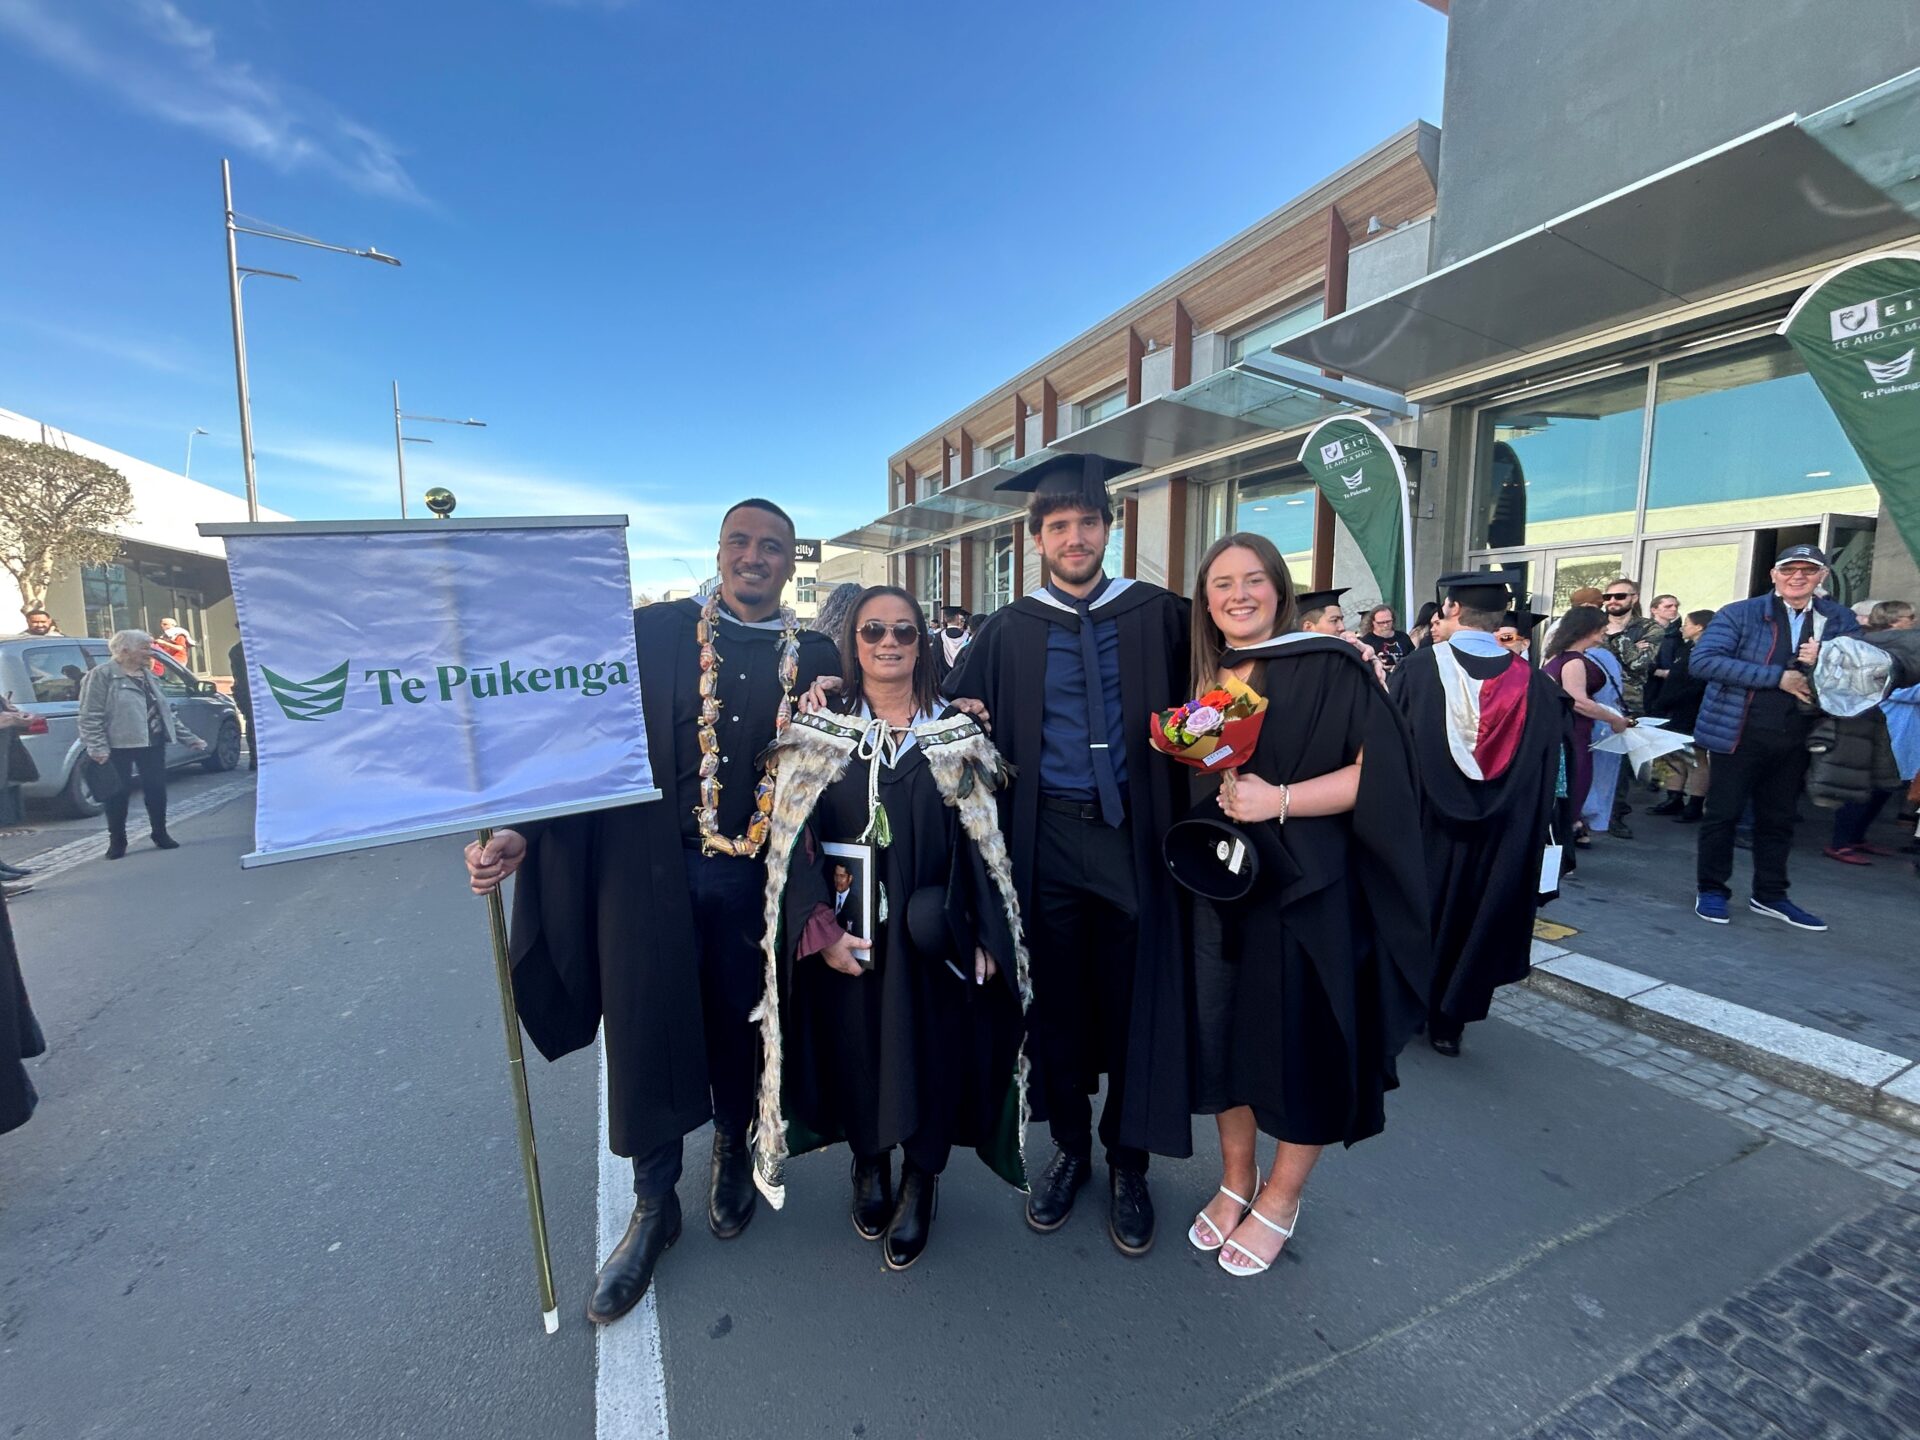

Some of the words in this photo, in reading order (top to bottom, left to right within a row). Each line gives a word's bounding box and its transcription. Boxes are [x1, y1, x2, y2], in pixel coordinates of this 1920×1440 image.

[1884, 298, 1920, 317] EI
[1833, 340, 1849, 351] TE
[1854, 331, 1885, 346] AHO
[1890, 327, 1900, 337] A
[1904, 322, 1920, 332] M
[1860, 390, 1875, 399] Te
[1876, 381, 1920, 396] Pūkeng
[1343, 438, 1364, 450] EIT
[1334, 458, 1348, 467] AHO
[1343, 492, 1349, 500] Te
[364, 668, 427, 705] Te
[436, 660, 630, 702] Pūkenga
